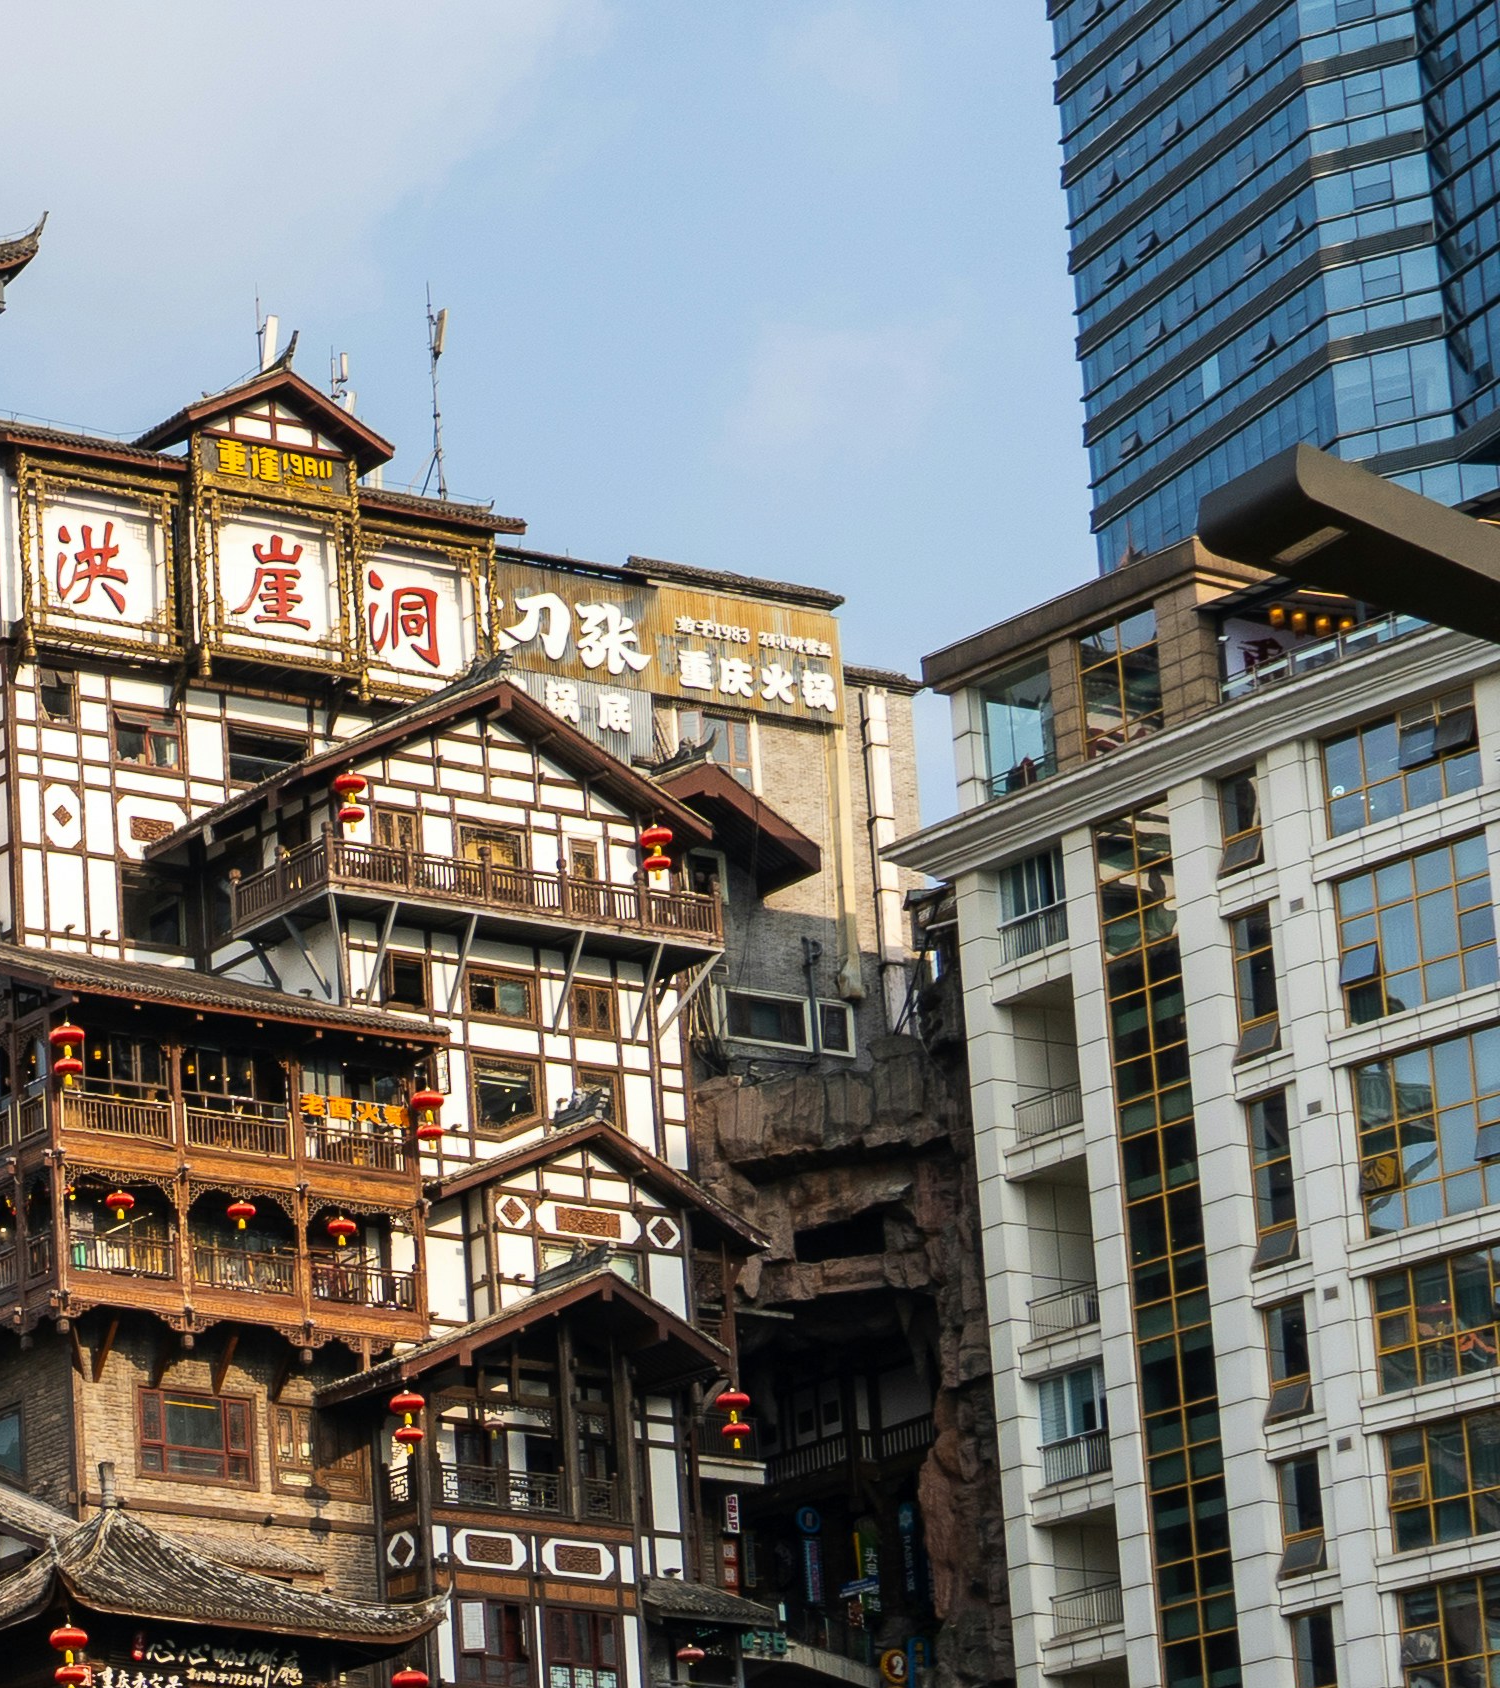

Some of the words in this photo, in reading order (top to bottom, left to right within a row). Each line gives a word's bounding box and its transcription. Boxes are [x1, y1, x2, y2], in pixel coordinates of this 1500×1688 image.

[56, 522, 439, 667] 洪崖洞
[509, 674, 632, 733] 锅底
[679, 650, 837, 713] 重庆火锅
